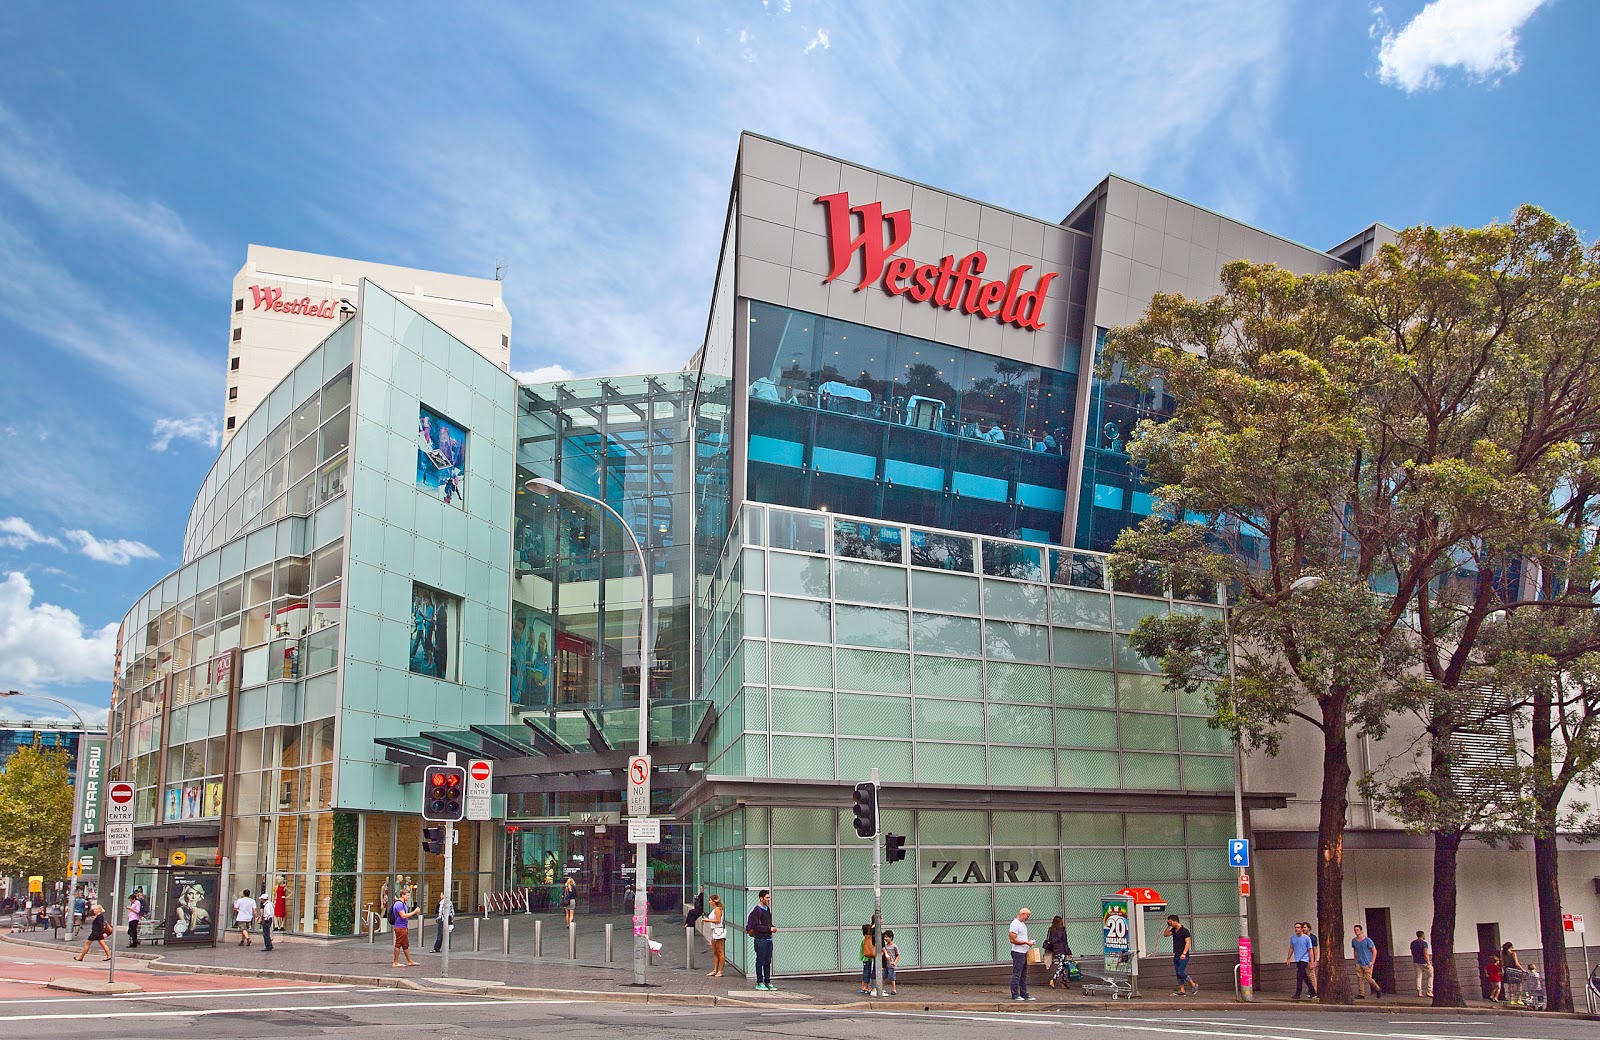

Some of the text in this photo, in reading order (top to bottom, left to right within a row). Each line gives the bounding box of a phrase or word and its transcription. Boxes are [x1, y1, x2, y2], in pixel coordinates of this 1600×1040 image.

[814, 191, 1060, 331] Westfield
[248, 284, 339, 319] Westfield
[84, 746, 101, 834] G-STAR RAW
[633, 787, 644, 796] NO
[1233, 841, 1244, 854] P
[930, 860, 1055, 884] ZARA
[1106, 918, 1126, 938] 20
